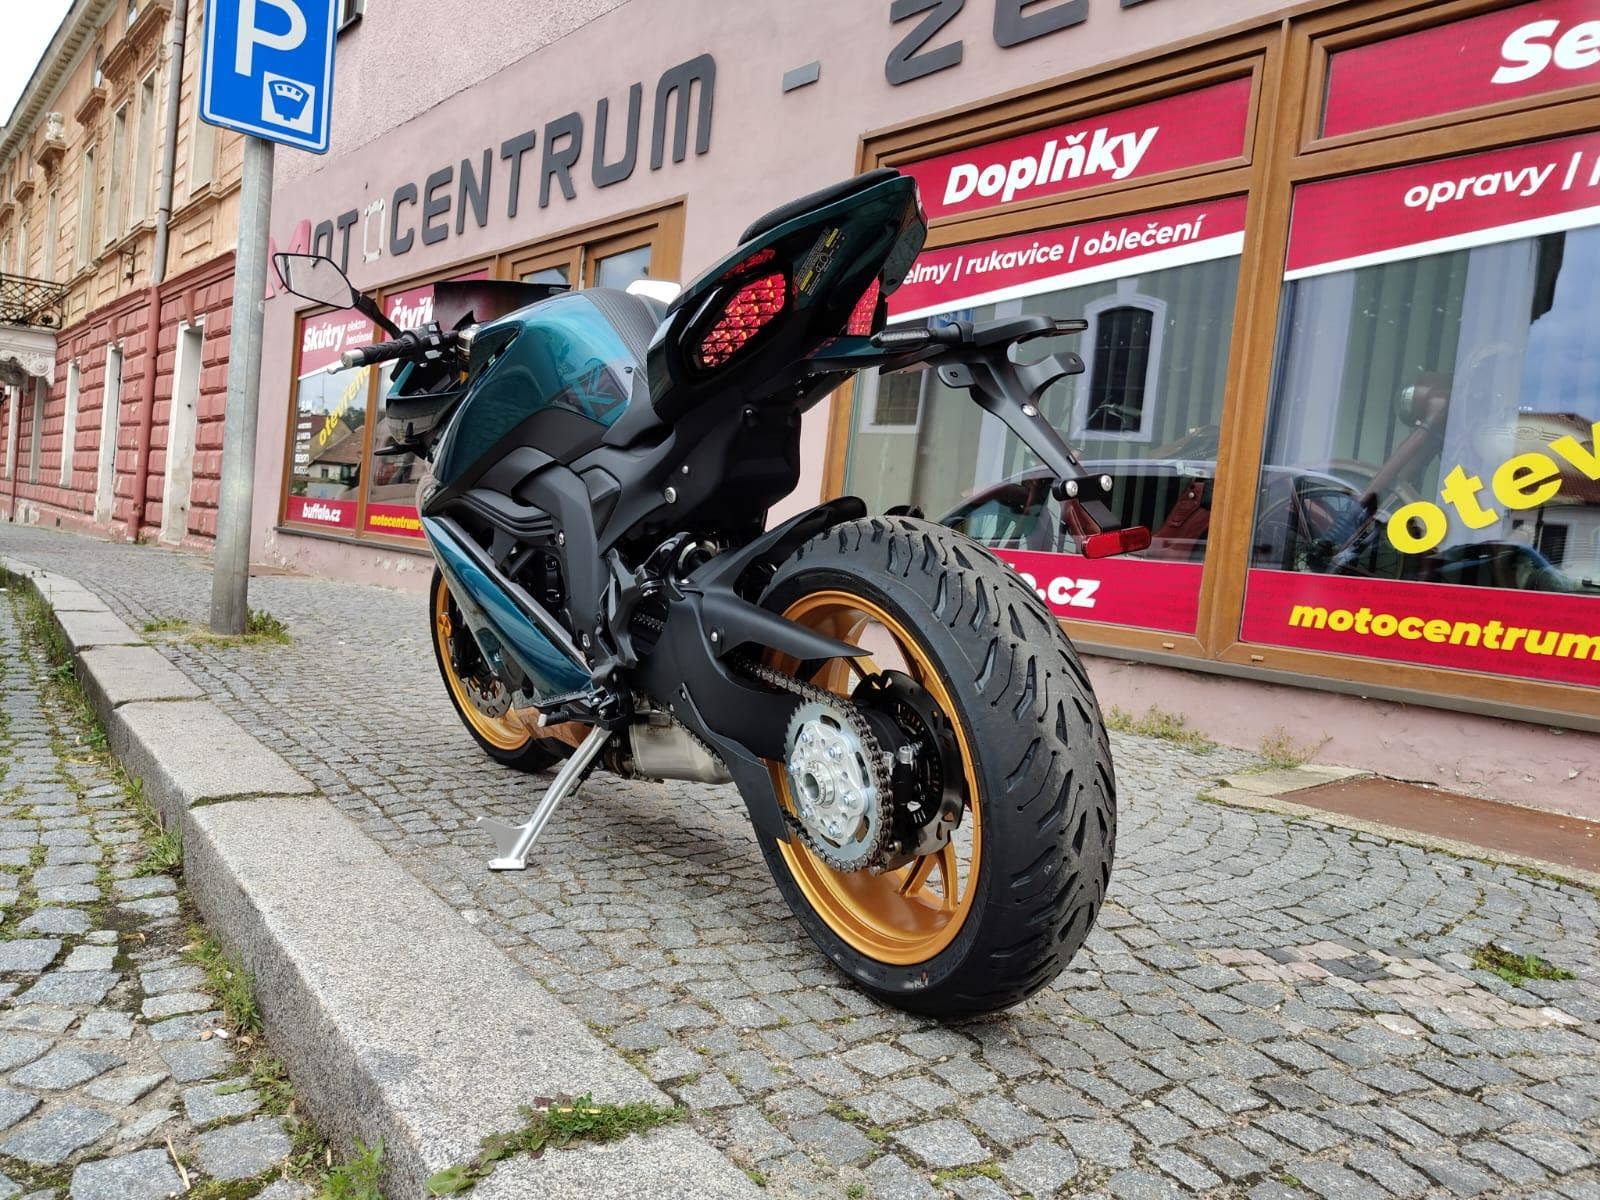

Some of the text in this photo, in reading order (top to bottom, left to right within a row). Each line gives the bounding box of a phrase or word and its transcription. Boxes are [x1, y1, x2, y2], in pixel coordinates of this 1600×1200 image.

[234, 0, 307, 77] P
[942, 126, 1159, 205] Doplňky
[1403, 163, 1556, 212] opravy
[903, 262, 951, 285] elmy
[965, 241, 1065, 275] rukavice
[1083, 214, 1206, 255] oblečení
[303, 321, 346, 352] Skútry
[302, 502, 342, 522] buffalo.cz
[370, 514, 423, 531] motocentrum-
[1008, 563, 1100, 608] .cz
[1288, 604, 1600, 661] motocentrum
